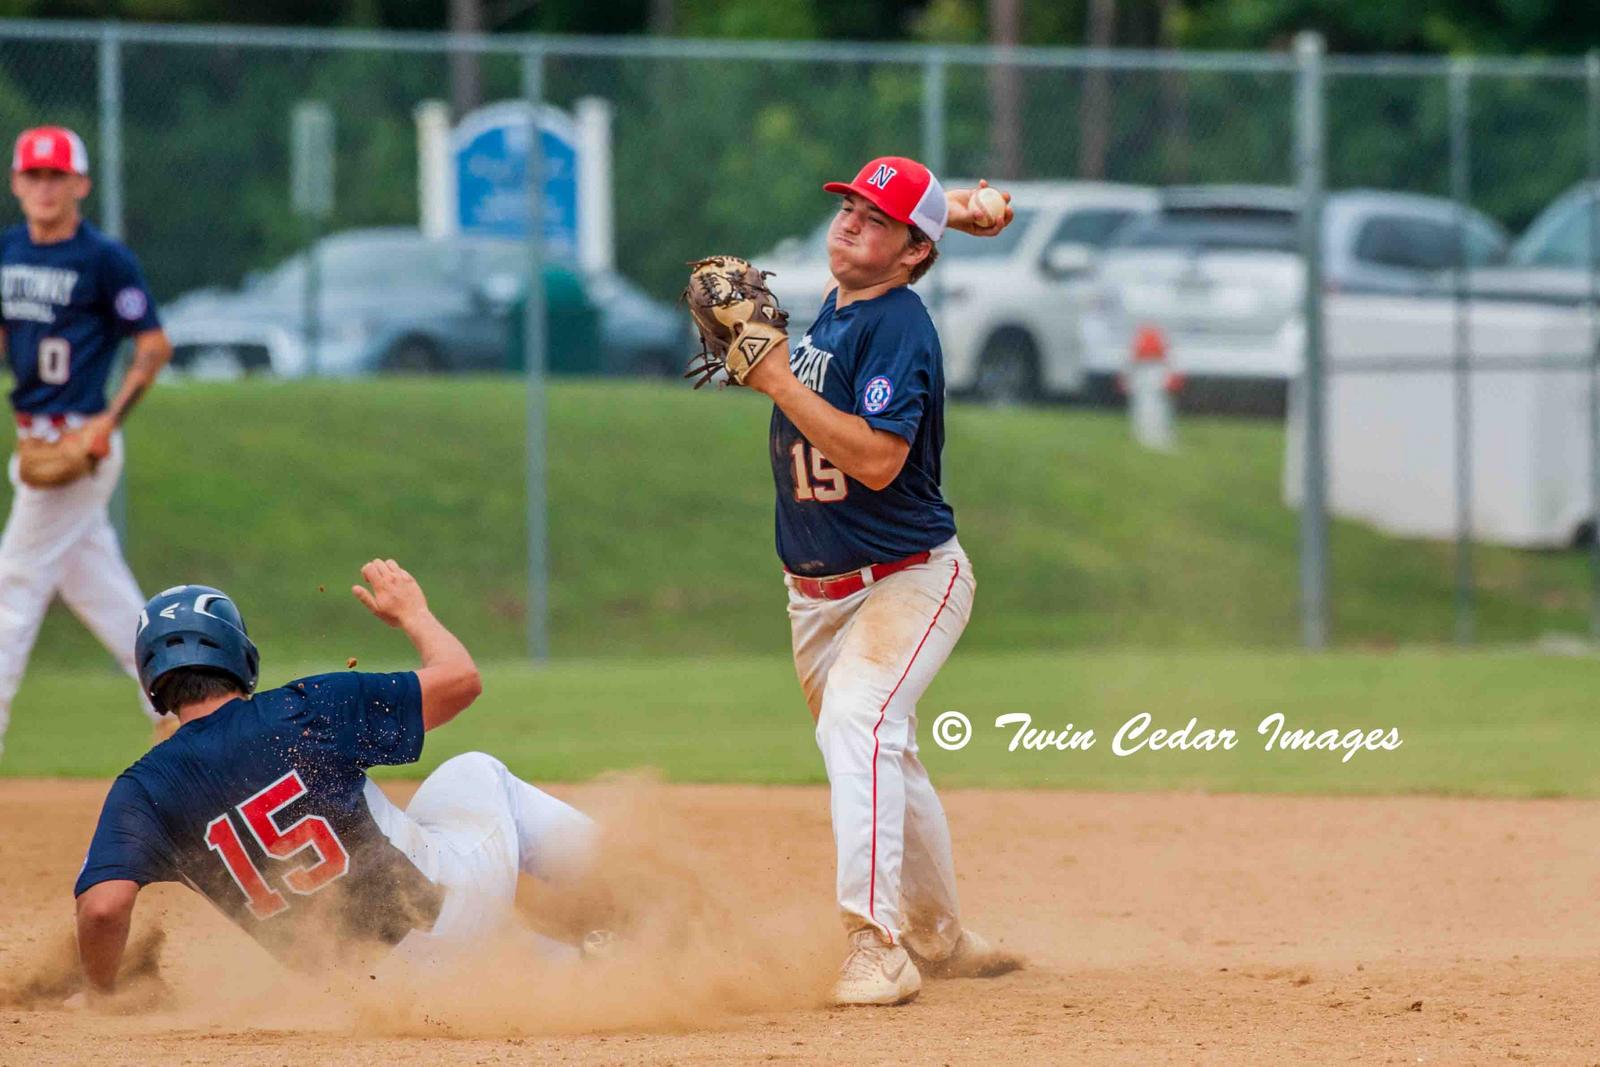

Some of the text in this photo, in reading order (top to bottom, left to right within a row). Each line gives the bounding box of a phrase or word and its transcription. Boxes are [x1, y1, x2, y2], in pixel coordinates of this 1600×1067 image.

[867, 163, 898, 190] N
[38, 336, 71, 385] 0
[790, 440, 848, 503] 15
[204, 769, 350, 920] 15
